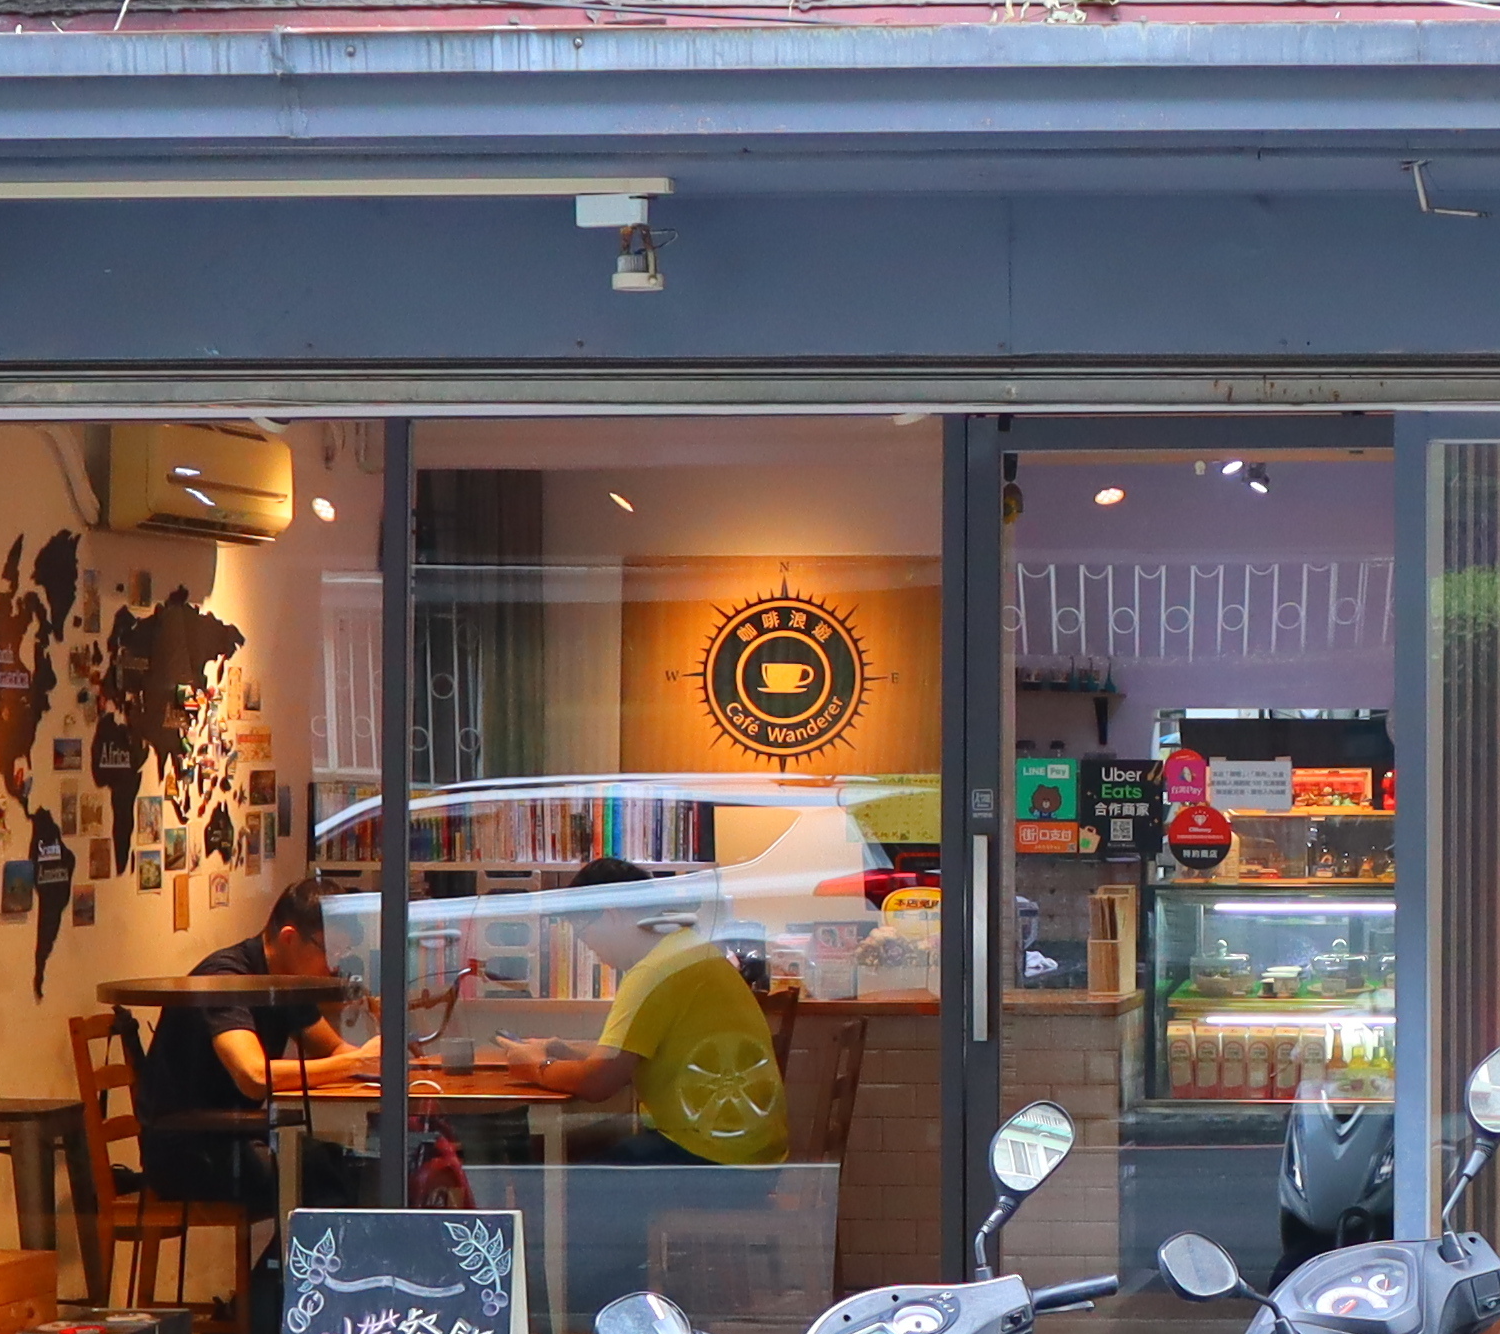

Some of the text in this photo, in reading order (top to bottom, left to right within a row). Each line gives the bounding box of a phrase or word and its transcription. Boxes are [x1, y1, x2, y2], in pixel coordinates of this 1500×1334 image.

[779, 562, 789, 572] N
[736, 610, 834, 643] 咖啡浪遊
[665, 671, 680, 682] W
[891, 673, 899, 683] E
[725, 695, 843, 743] Café Wanderer
[100, 746, 131, 768] Africa
[1023, 766, 1067, 778] LINE Pay
[1101, 767, 1142, 782] Uber
[1101, 784, 1142, 799] Eats
[1094, 803, 1150, 817] 合作商家
